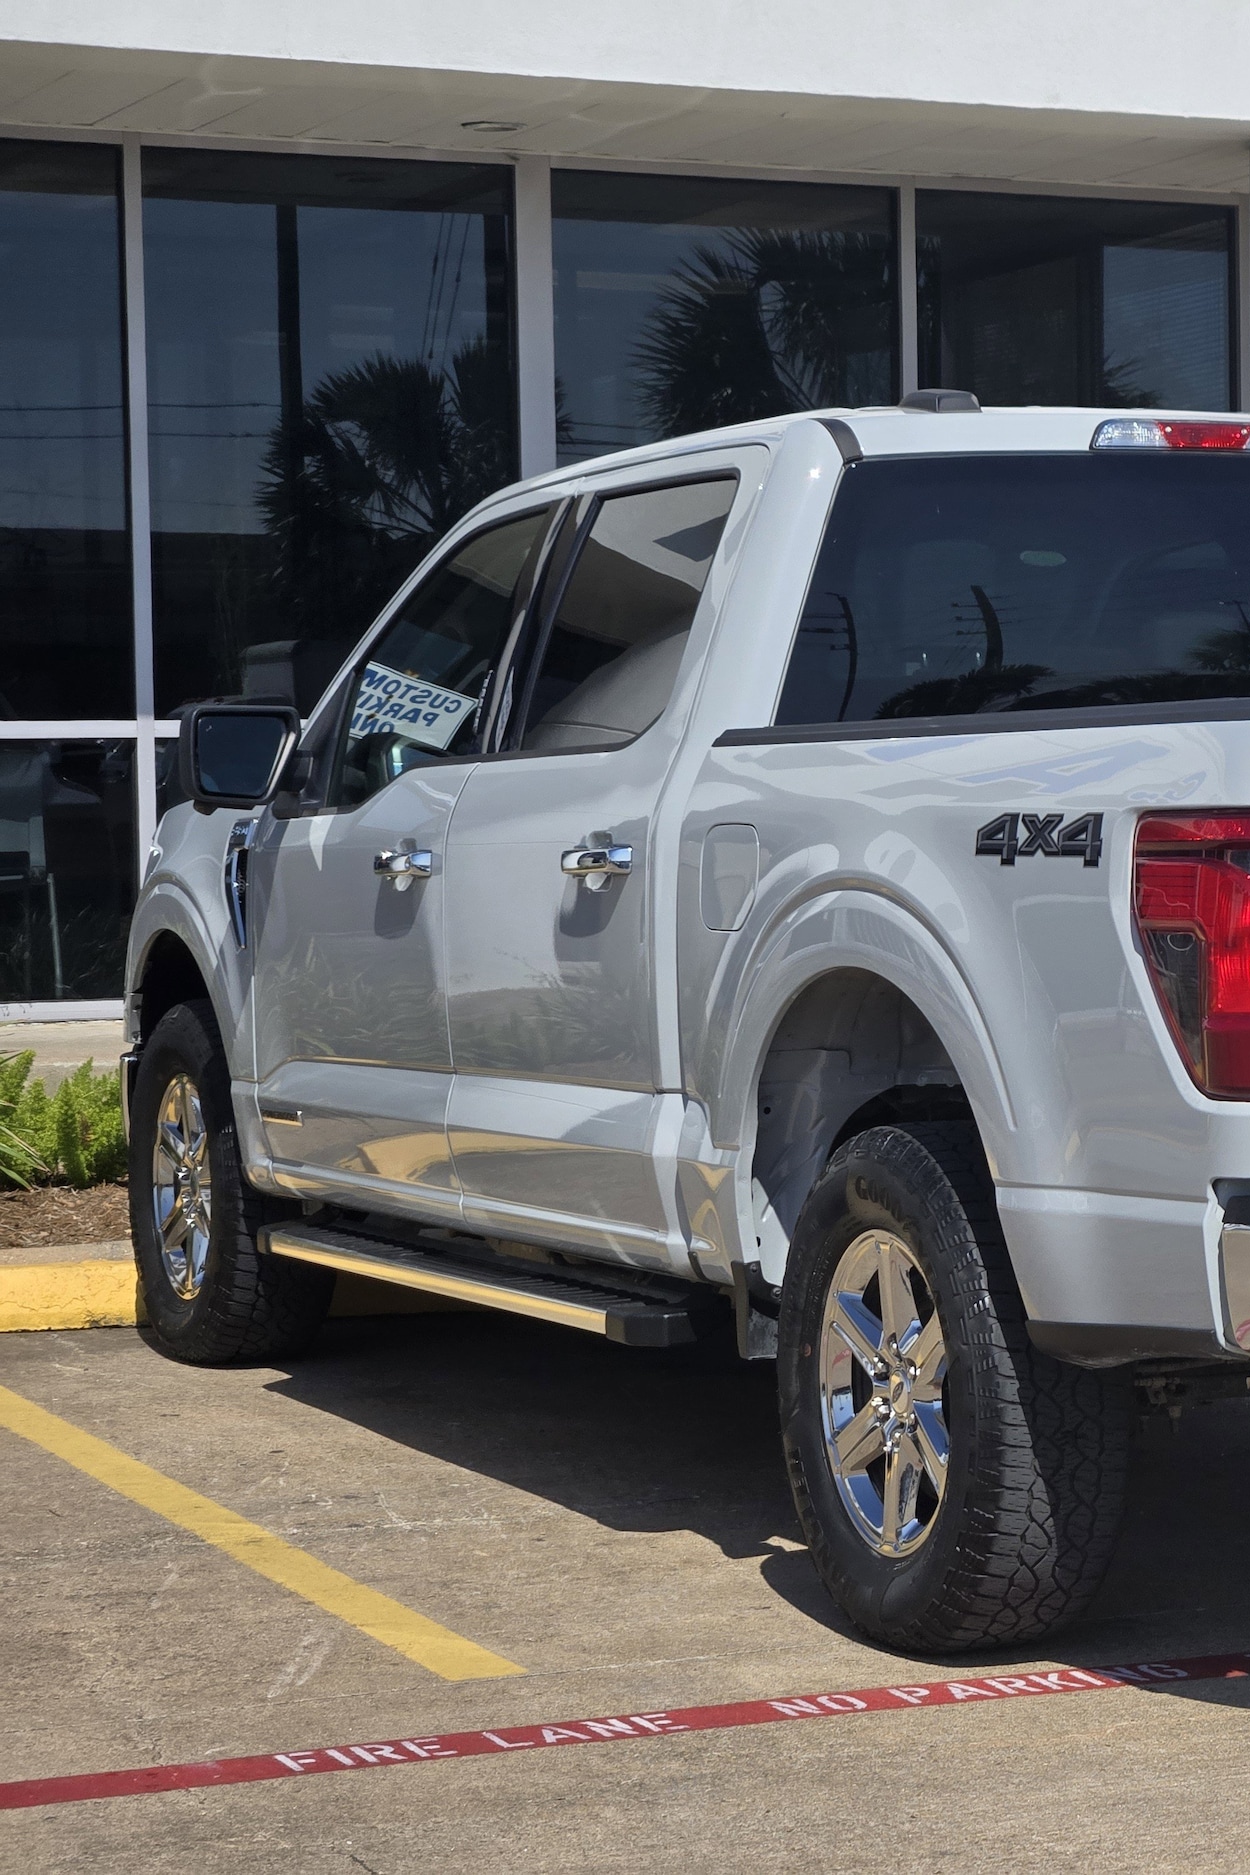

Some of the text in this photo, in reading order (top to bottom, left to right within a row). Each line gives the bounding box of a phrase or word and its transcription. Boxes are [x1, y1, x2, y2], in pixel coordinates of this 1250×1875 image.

[274, 1737, 458, 1772] FIRE
[482, 1713, 690, 1750] LANE
[767, 1694, 868, 1718] NO
[887, 1663, 1189, 1705] PARKING
